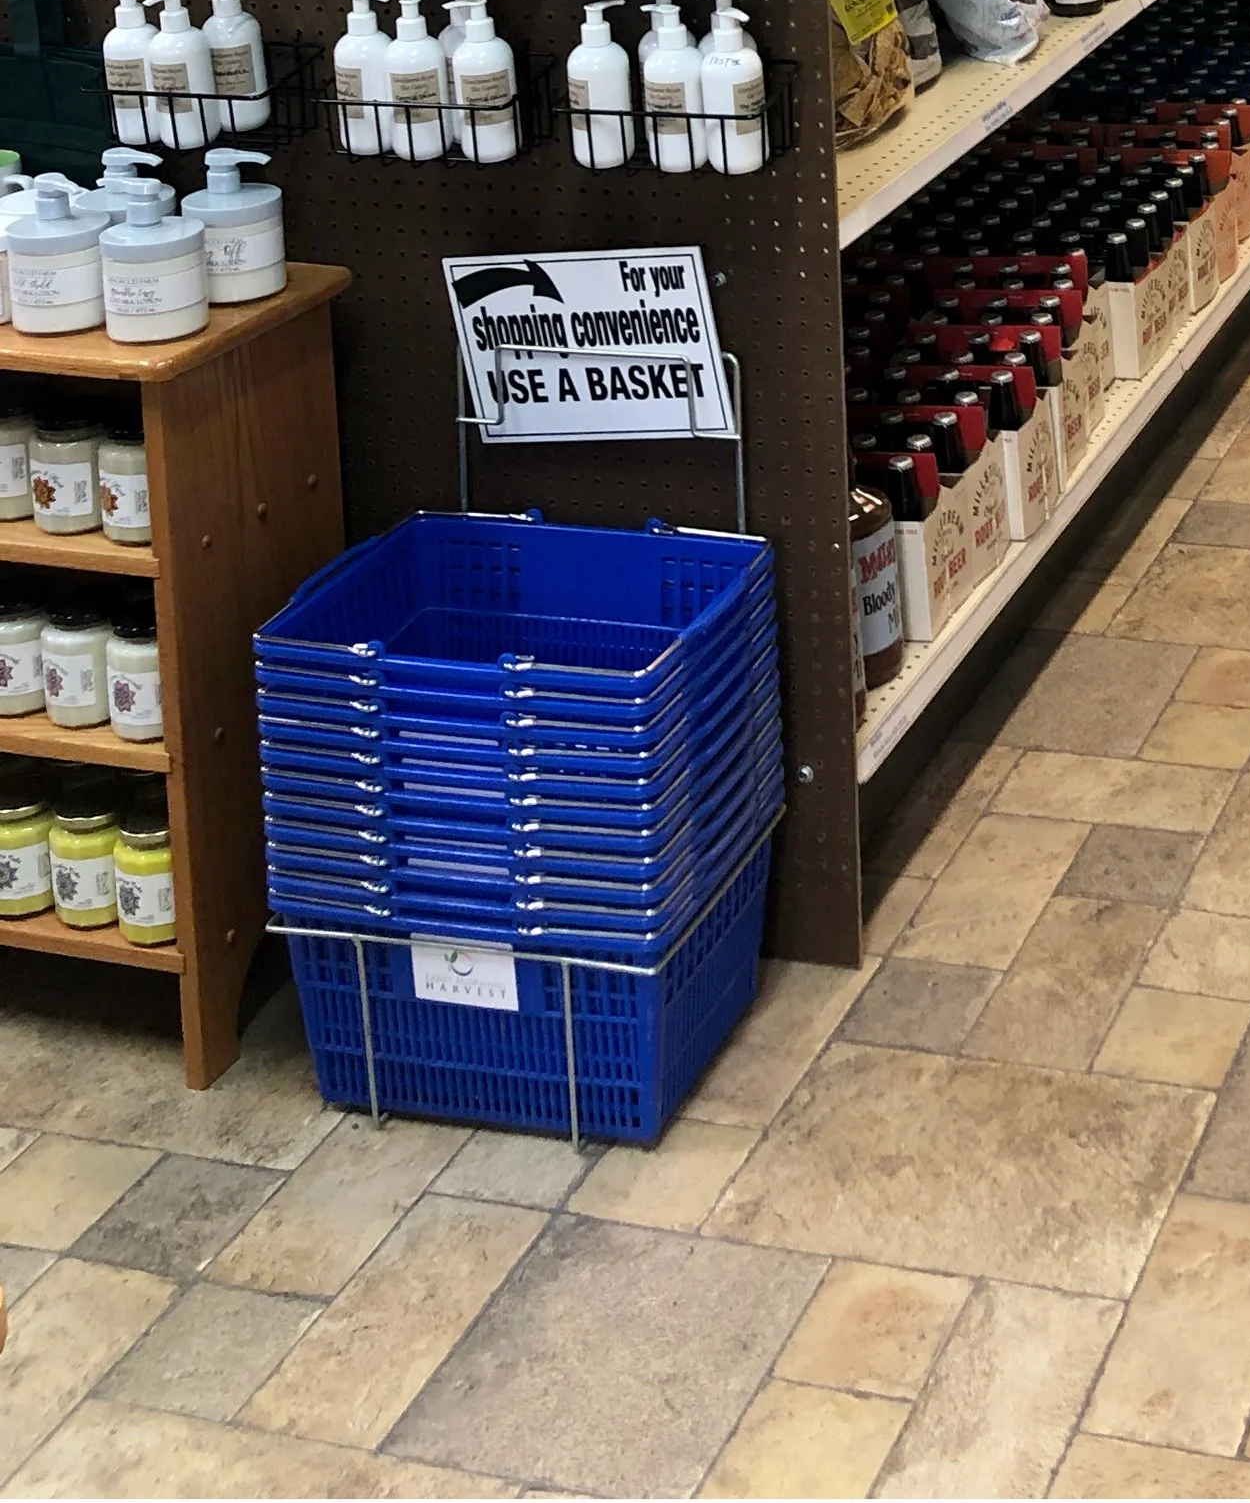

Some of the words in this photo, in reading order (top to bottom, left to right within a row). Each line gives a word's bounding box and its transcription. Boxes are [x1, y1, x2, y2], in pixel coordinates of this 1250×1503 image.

[619, 261, 646, 292] For
[649, 263, 685, 297] your
[472, 304, 568, 360] shopping
[570, 299, 700, 347] convenience
[487, 369, 550, 405] USE
[558, 368, 580, 402] A
[585, 364, 705, 402] BASKET
[948, 548, 967, 579] BEER
[426, 982, 506, 999] HARVEST
